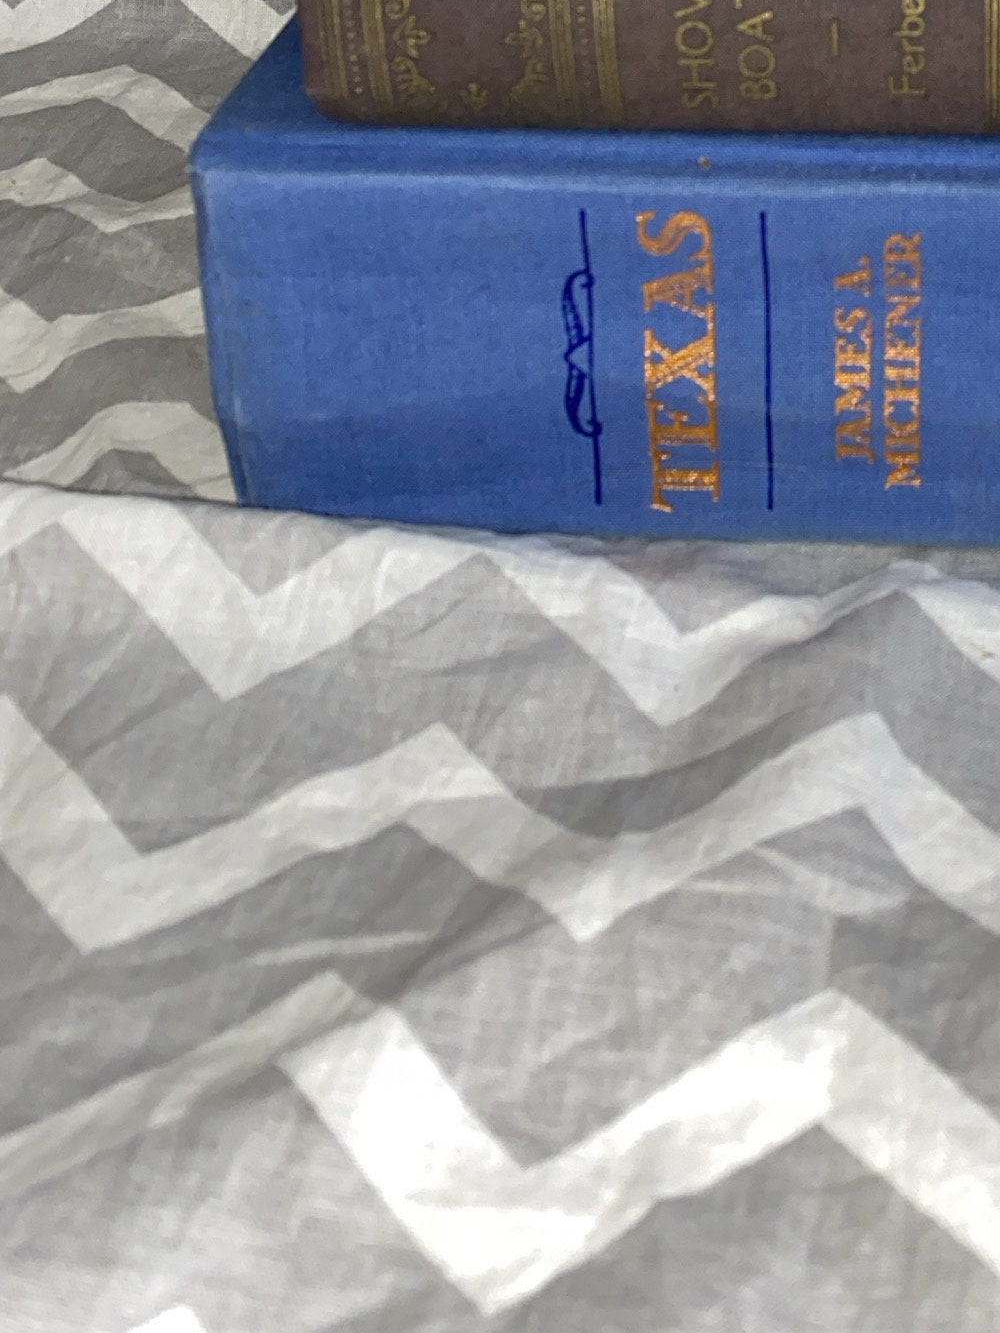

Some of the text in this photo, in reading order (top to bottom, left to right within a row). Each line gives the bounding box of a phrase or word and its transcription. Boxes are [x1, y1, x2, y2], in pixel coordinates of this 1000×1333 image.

[635, 209, 721, 513] TEXAS
[834, 254, 874, 464] JAMES A.
[883, 231, 922, 491] MICHENER
